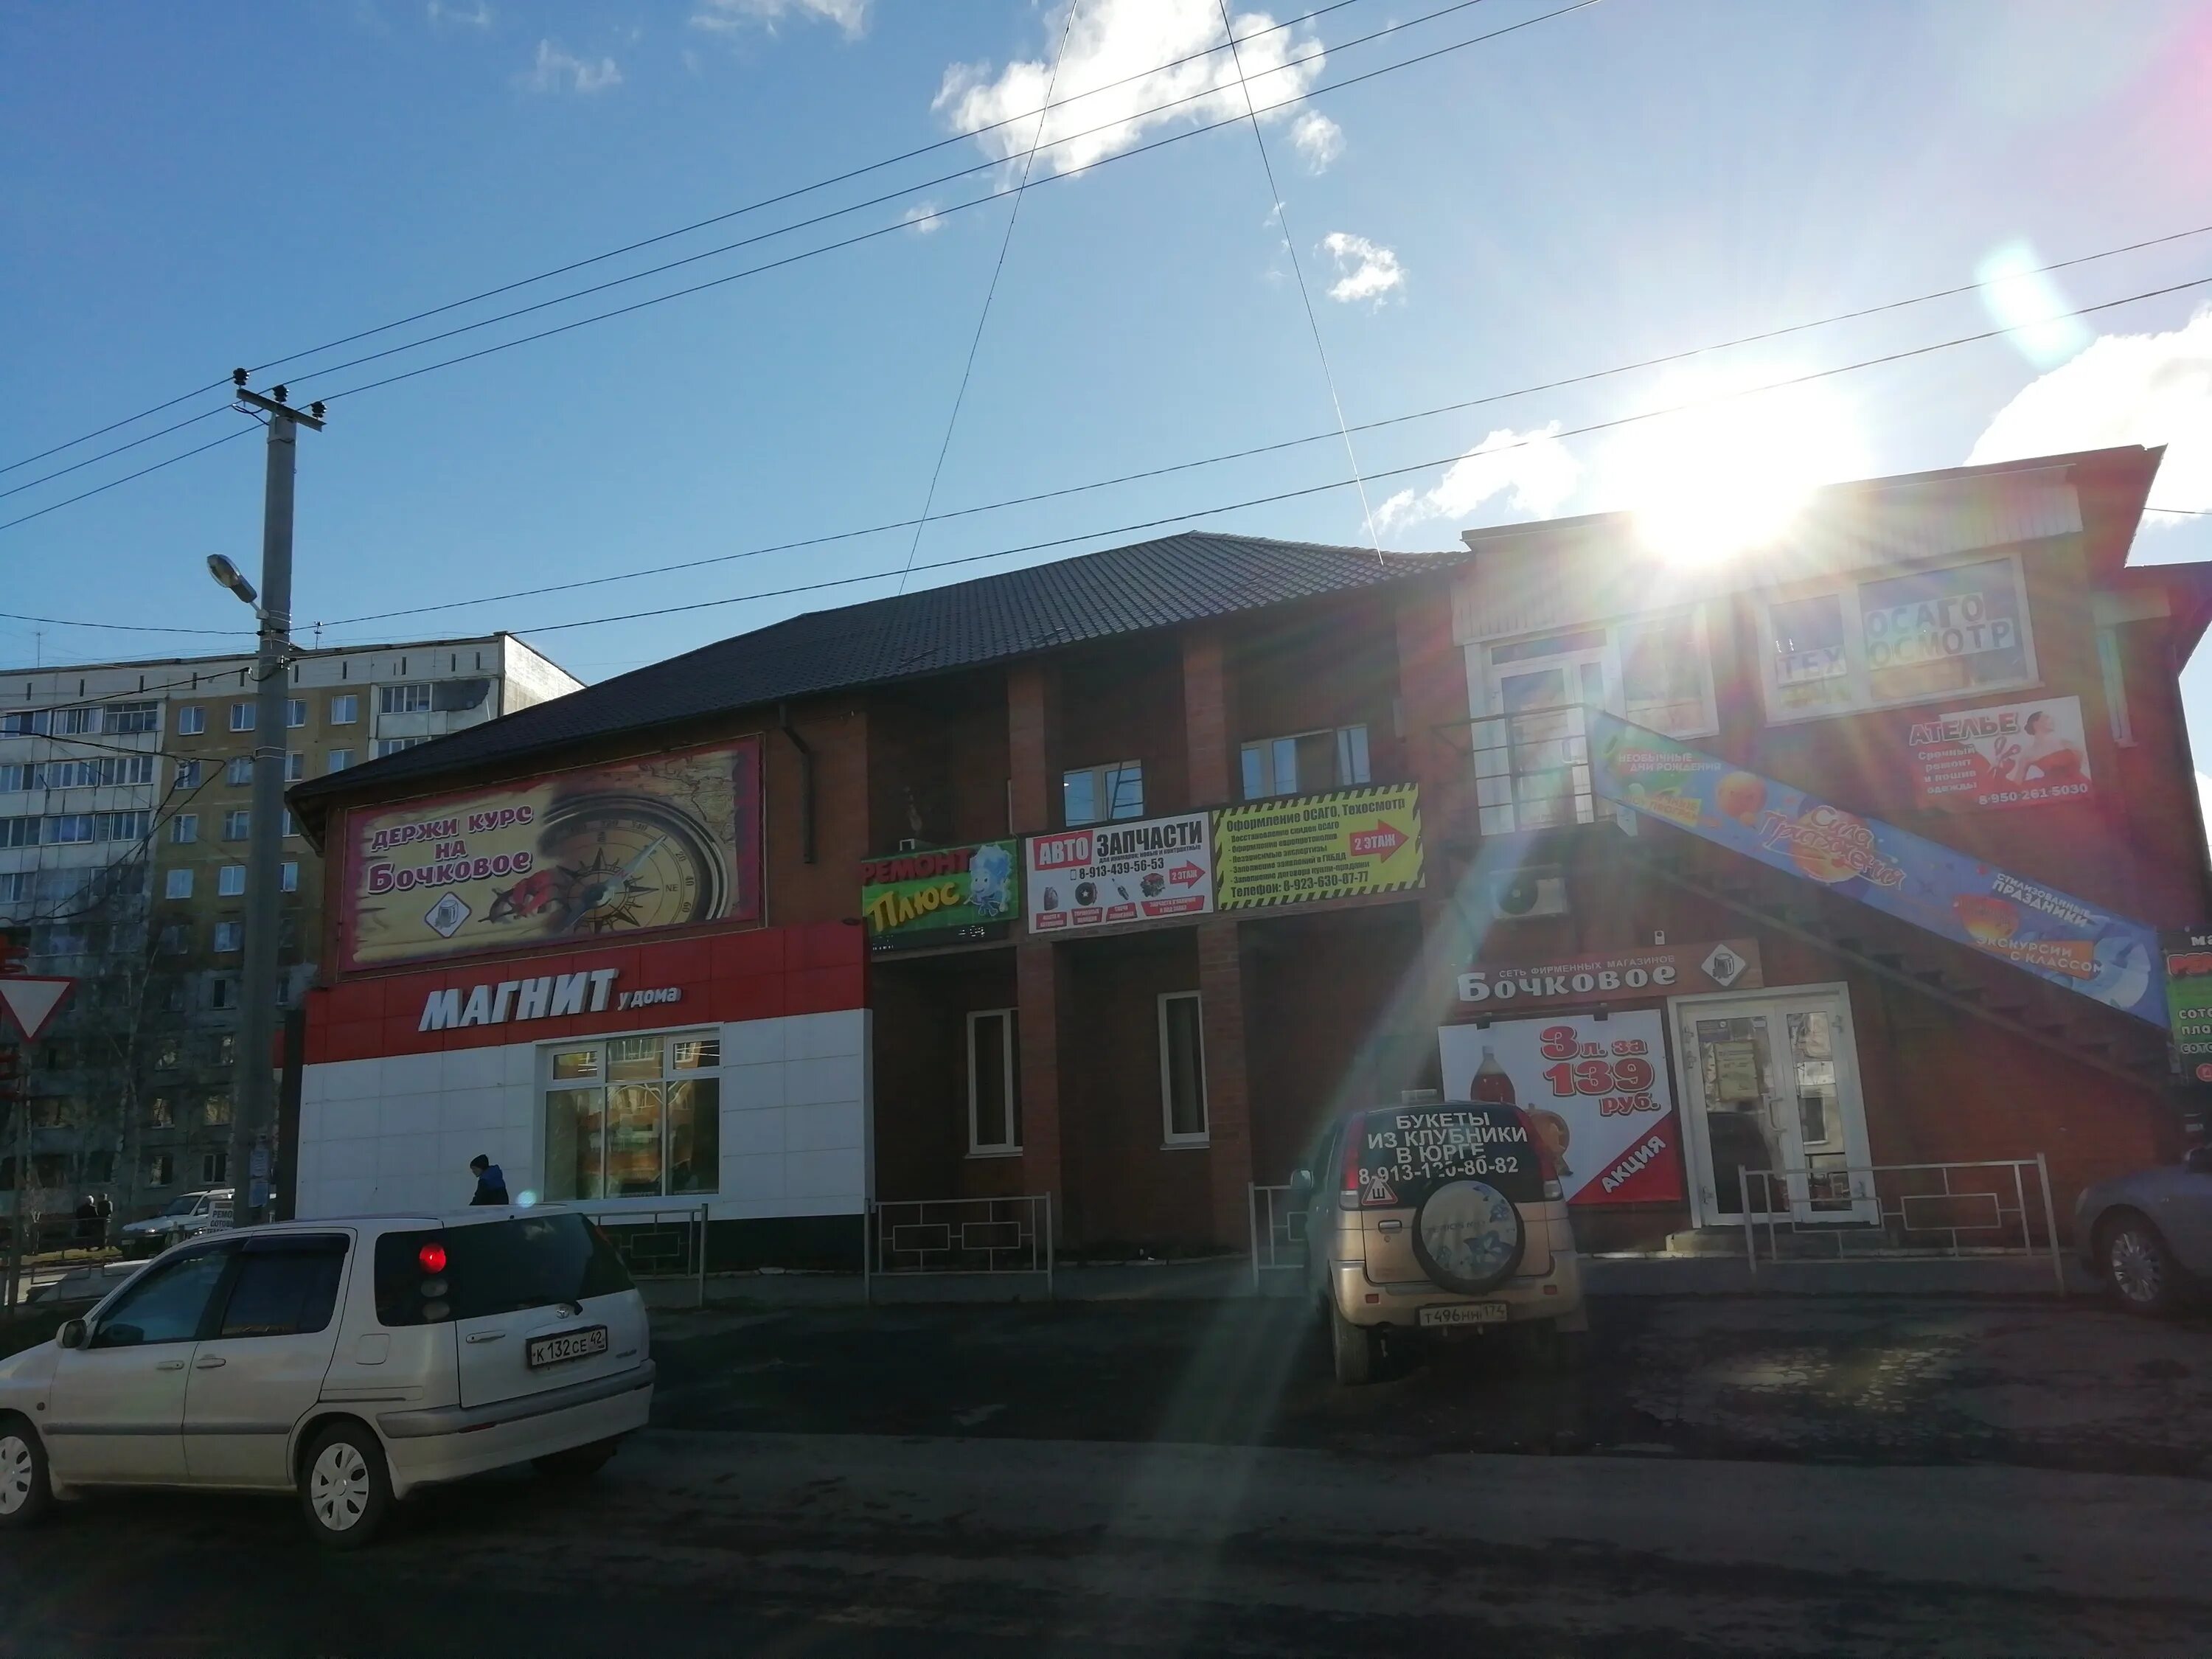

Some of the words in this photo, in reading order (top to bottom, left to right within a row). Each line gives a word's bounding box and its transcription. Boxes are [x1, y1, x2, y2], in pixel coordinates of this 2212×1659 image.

[1868, 594, 1984, 638] ОСАГО
[1778, 647, 1842, 679] ТЕХ
[1869, 621, 2011, 667] ОСМОТР
[1909, 712, 2019, 746] АТЕЛЬЕ
[1618, 752, 1694, 763] НЕОБЫЧНЫЕ
[1918, 744, 1977, 760] Срочный
[1630, 762, 1655, 773] ДНИ
[1657, 762, 1722, 773] РОЖДЕНИЯ
[1925, 758, 1972, 772] ремонт
[1935, 769, 1977, 782] пошив
[1927, 782, 1977, 795] одежды
[1226, 813, 1301, 832] Оформление
[1303, 805, 1340, 823] ОСАГО,
[1343, 797, 1405, 815] Техосмотр
[1318, 820, 1340, 831] ОСАГО
[371, 818, 459, 851] ДЕРЖИ
[468, 805, 534, 833] КУРС
[434, 840, 467, 861] НА
[1040, 837, 1089, 866] АВТО
[1096, 820, 1203, 857] ЗАПЧАСТИ
[1354, 838, 1363, 850] 2
[1363, 834, 1396, 849] ЭТАЖ
[368, 850, 533, 894] Бочковое
[860, 848, 971, 886] РЕМОНТ
[1079, 857, 1165, 880] 8-913-439-56-53
[1172, 872, 1178, 881] 2
[1179, 869, 1198, 880] ЭТАЖ
[665, 884, 678, 892] NE
[1231, 883, 1282, 898] Телефон:
[1283, 870, 1369, 891] 8-923-630-07-77
[1992, 879, 2089, 928] ПРАЗДНИКИ
[1975, 935, 2073, 957] ЭКСКУРСИИ
[1498, 969, 1527, 978] СЕТЬ
[1530, 961, 1602, 975] ФИРМЕННЫХ
[1607, 953, 1676, 969] МАГАЗИНОВ
[2010, 950, 2020, 961] С
[2025, 951, 2105, 974] КЛАССОМ
[1458, 964, 1677, 1002] Бочковое
[418, 967, 620, 1032] МАГНИТ
[616, 990, 633, 1012] у
[630, 987, 683, 1008] дома
[1540, 1025, 1579, 1060] 3
[1610, 1037, 1648, 1057] за
[1543, 1057, 1656, 1097] 139
[1599, 1092, 1661, 1118] руб.
[1396, 1112, 1490, 1130] БУКЕТЫ
[1368, 1132, 1399, 1150] ИЗ
[1404, 1127, 1528, 1147] КЛУБНИКИ
[1395, 1147, 1413, 1164] В
[1419, 1142, 1486, 1163] ЮРГЕ
[1601, 1135, 1667, 1194] АКЦИЯ
[1373, 1187, 1386, 1200] Ш
